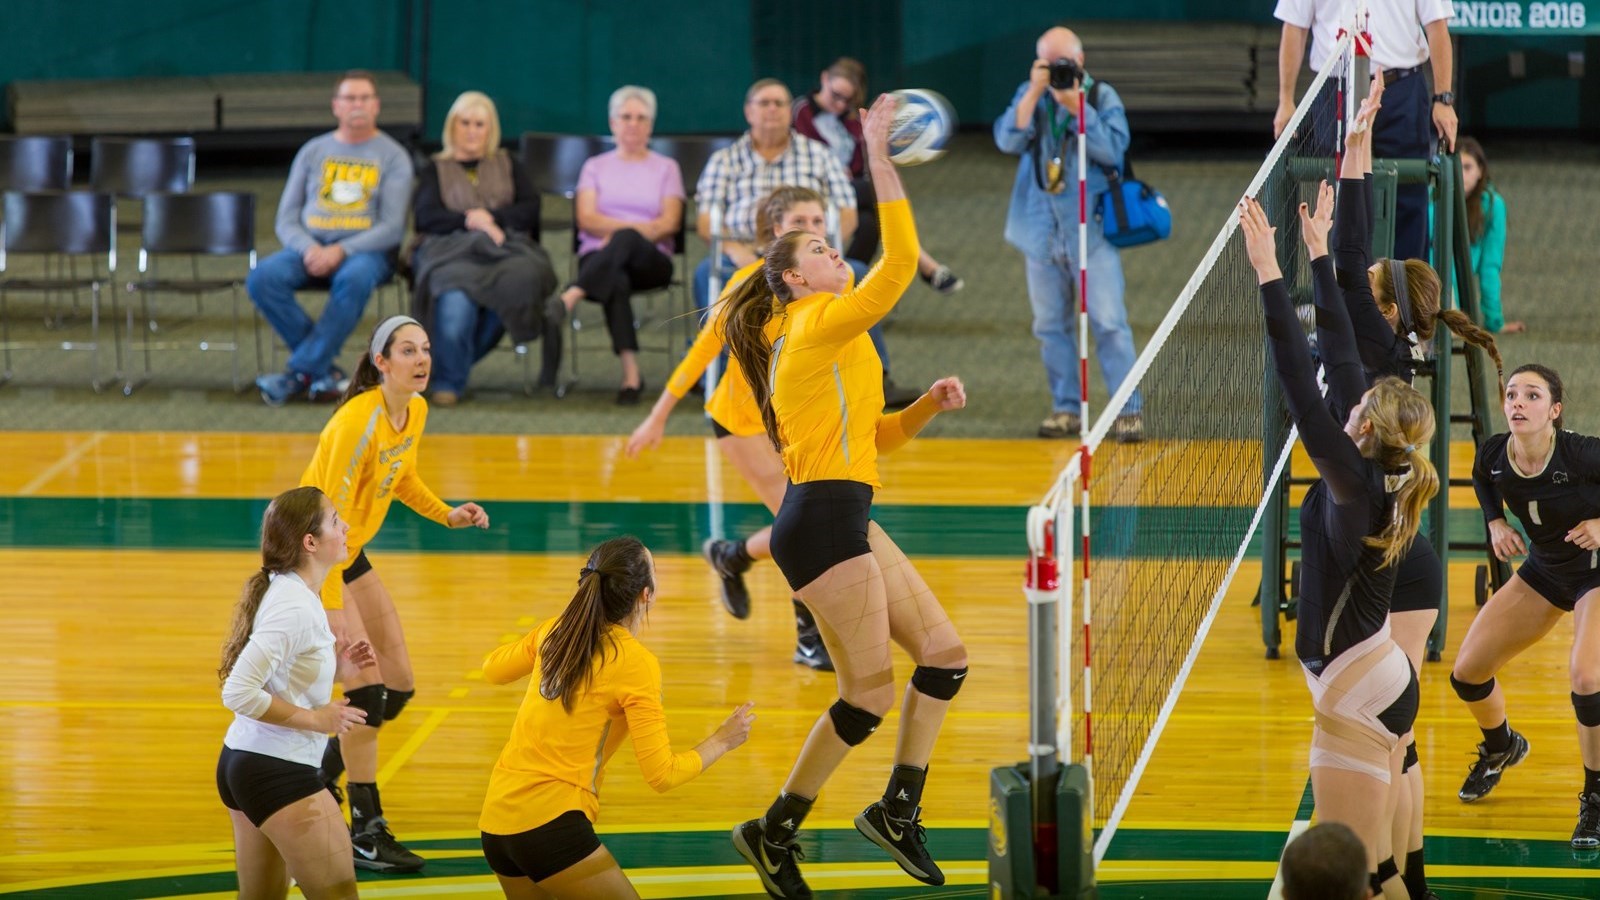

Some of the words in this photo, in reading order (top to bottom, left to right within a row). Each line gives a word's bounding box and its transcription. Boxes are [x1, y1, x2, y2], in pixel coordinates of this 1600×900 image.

[1448, 2, 1522, 28] ENIOR
[1529, 2, 1586, 28] 2016
[1528, 500, 1542, 526] 1
